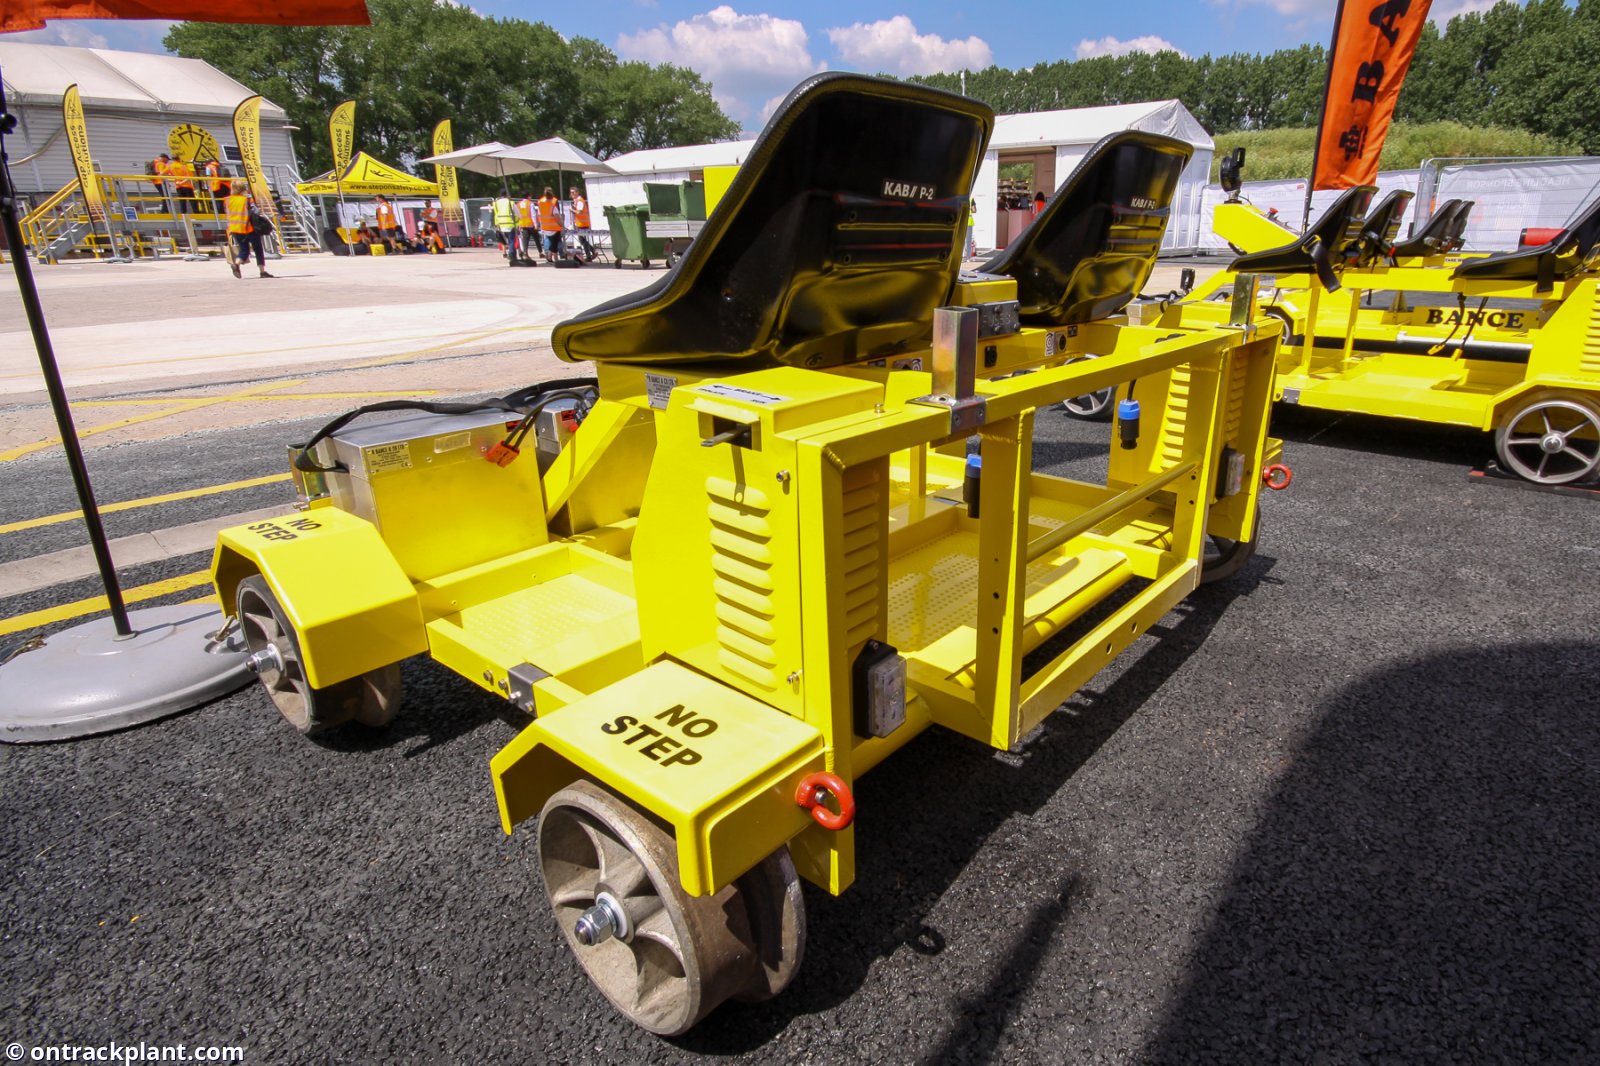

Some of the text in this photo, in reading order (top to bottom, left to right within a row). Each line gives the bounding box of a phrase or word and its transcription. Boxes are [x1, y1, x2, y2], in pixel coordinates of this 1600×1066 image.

[70, 124, 84, 164] Access
[239, 126, 257, 184] GRP Access
[342, 129, 351, 169] Solutions
[440, 180, 449, 197] GRP
[919, 186, 934, 200] P-2
[1425, 309, 1525, 329] BANCE
[247, 522, 298, 541] STEP
[285, 518, 322, 531] NO
[654, 703, 719, 738] NO
[600, 715, 703, 767] STEP
